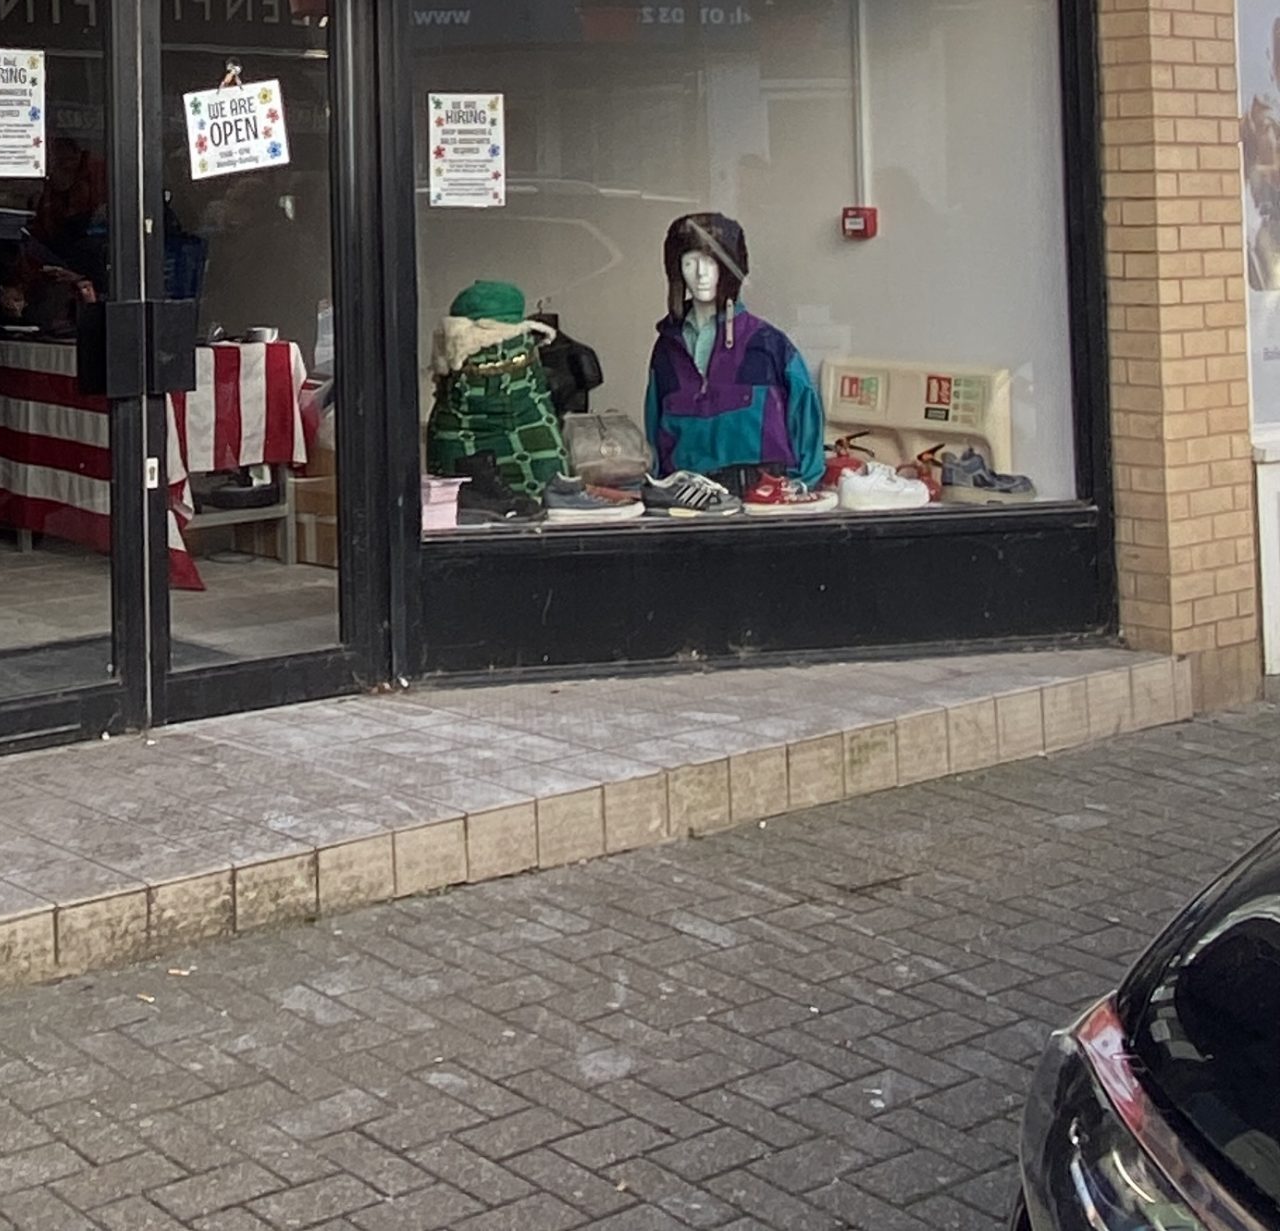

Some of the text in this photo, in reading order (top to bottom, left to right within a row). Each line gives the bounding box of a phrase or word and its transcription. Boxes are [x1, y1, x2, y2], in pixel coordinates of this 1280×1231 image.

[207, 96, 256, 120] WE ARE
[445, 109, 487, 125] HIRING
[210, 115, 260, 147] OPEN
